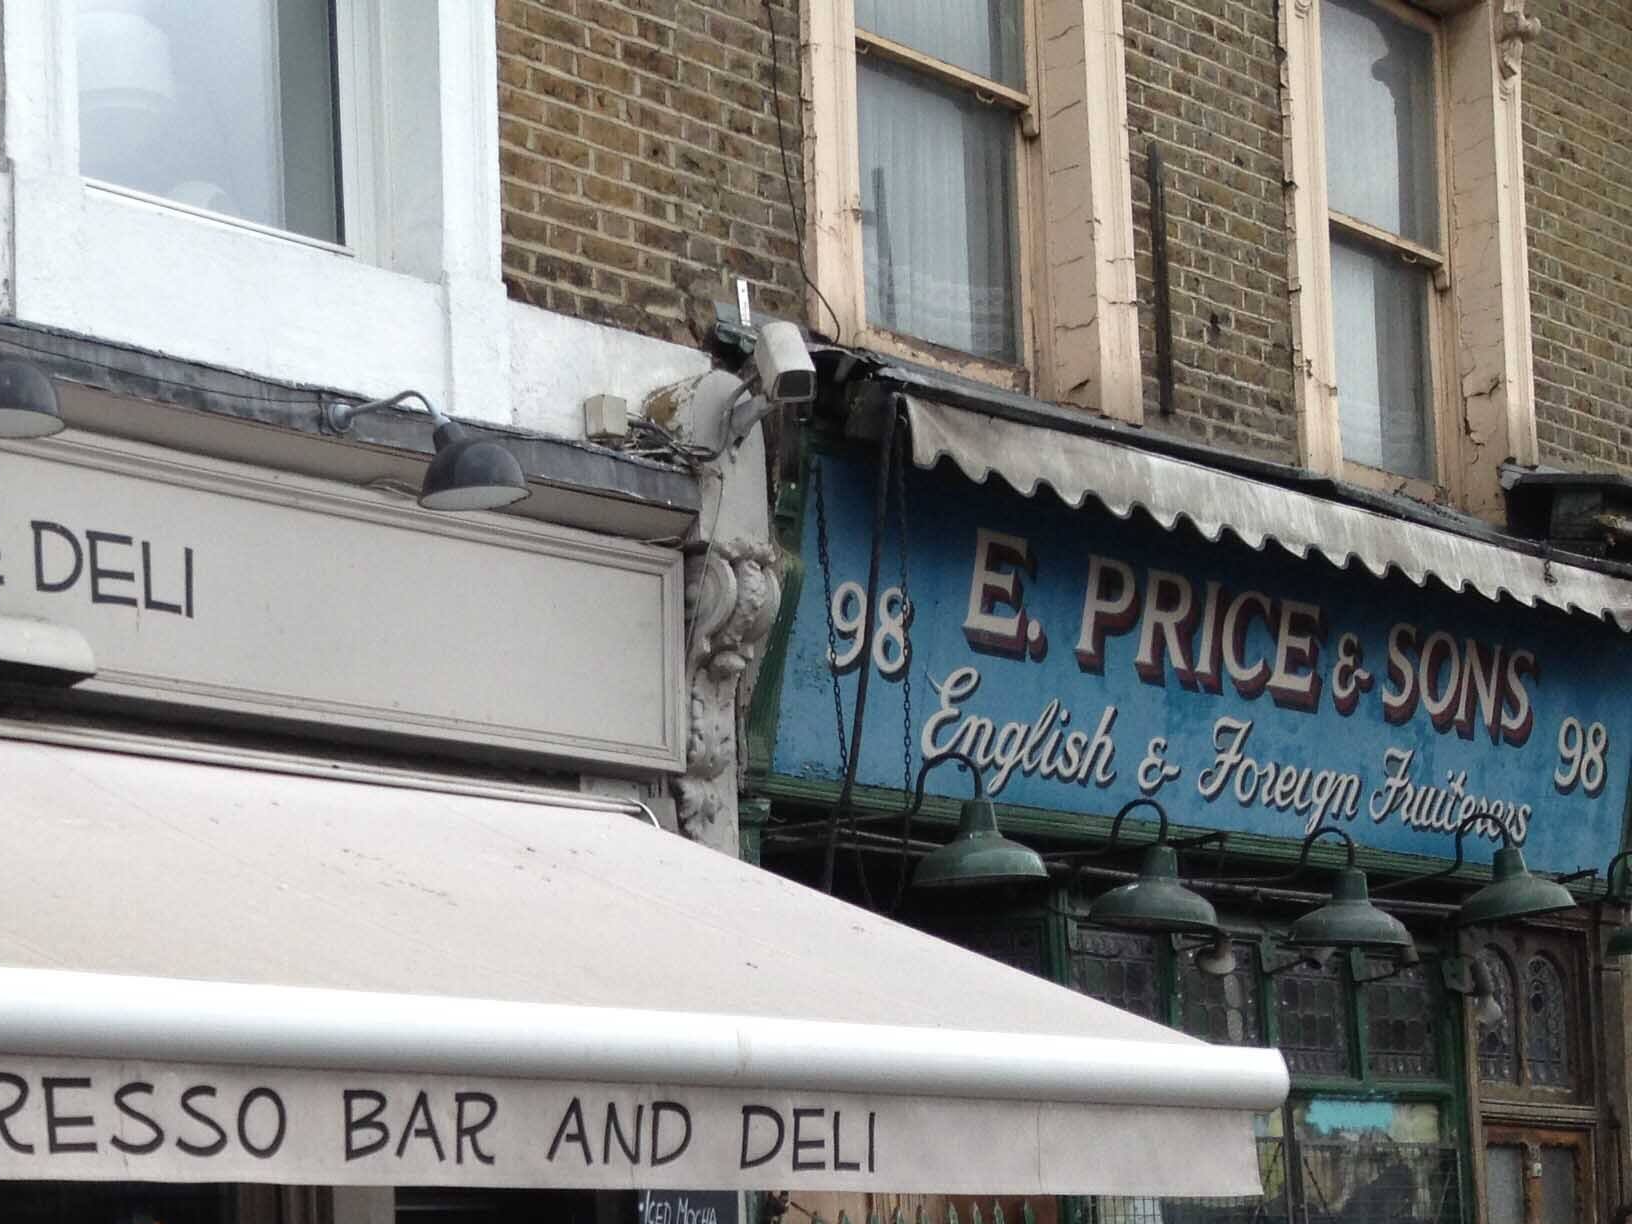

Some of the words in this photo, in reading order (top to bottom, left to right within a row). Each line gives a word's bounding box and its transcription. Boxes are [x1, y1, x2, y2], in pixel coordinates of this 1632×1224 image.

[30, 519, 195, 619] DELI
[827, 581, 911, 674] 98
[962, 527, 1044, 650] E.
[1074, 554, 1322, 695] PRICE
[1333, 632, 1370, 700] &
[1382, 622, 1536, 735] SONS
[921, 666, 1117, 795] English
[1136, 737, 1181, 790] &
[1197, 716, 1359, 833] Foreign
[1369, 747, 1532, 843] Fruiterers
[1554, 716, 1608, 791] 98
[343, 1088, 500, 1168] BAR
[546, 1099, 693, 1168] AND
[740, 1106, 879, 1174] DELI
